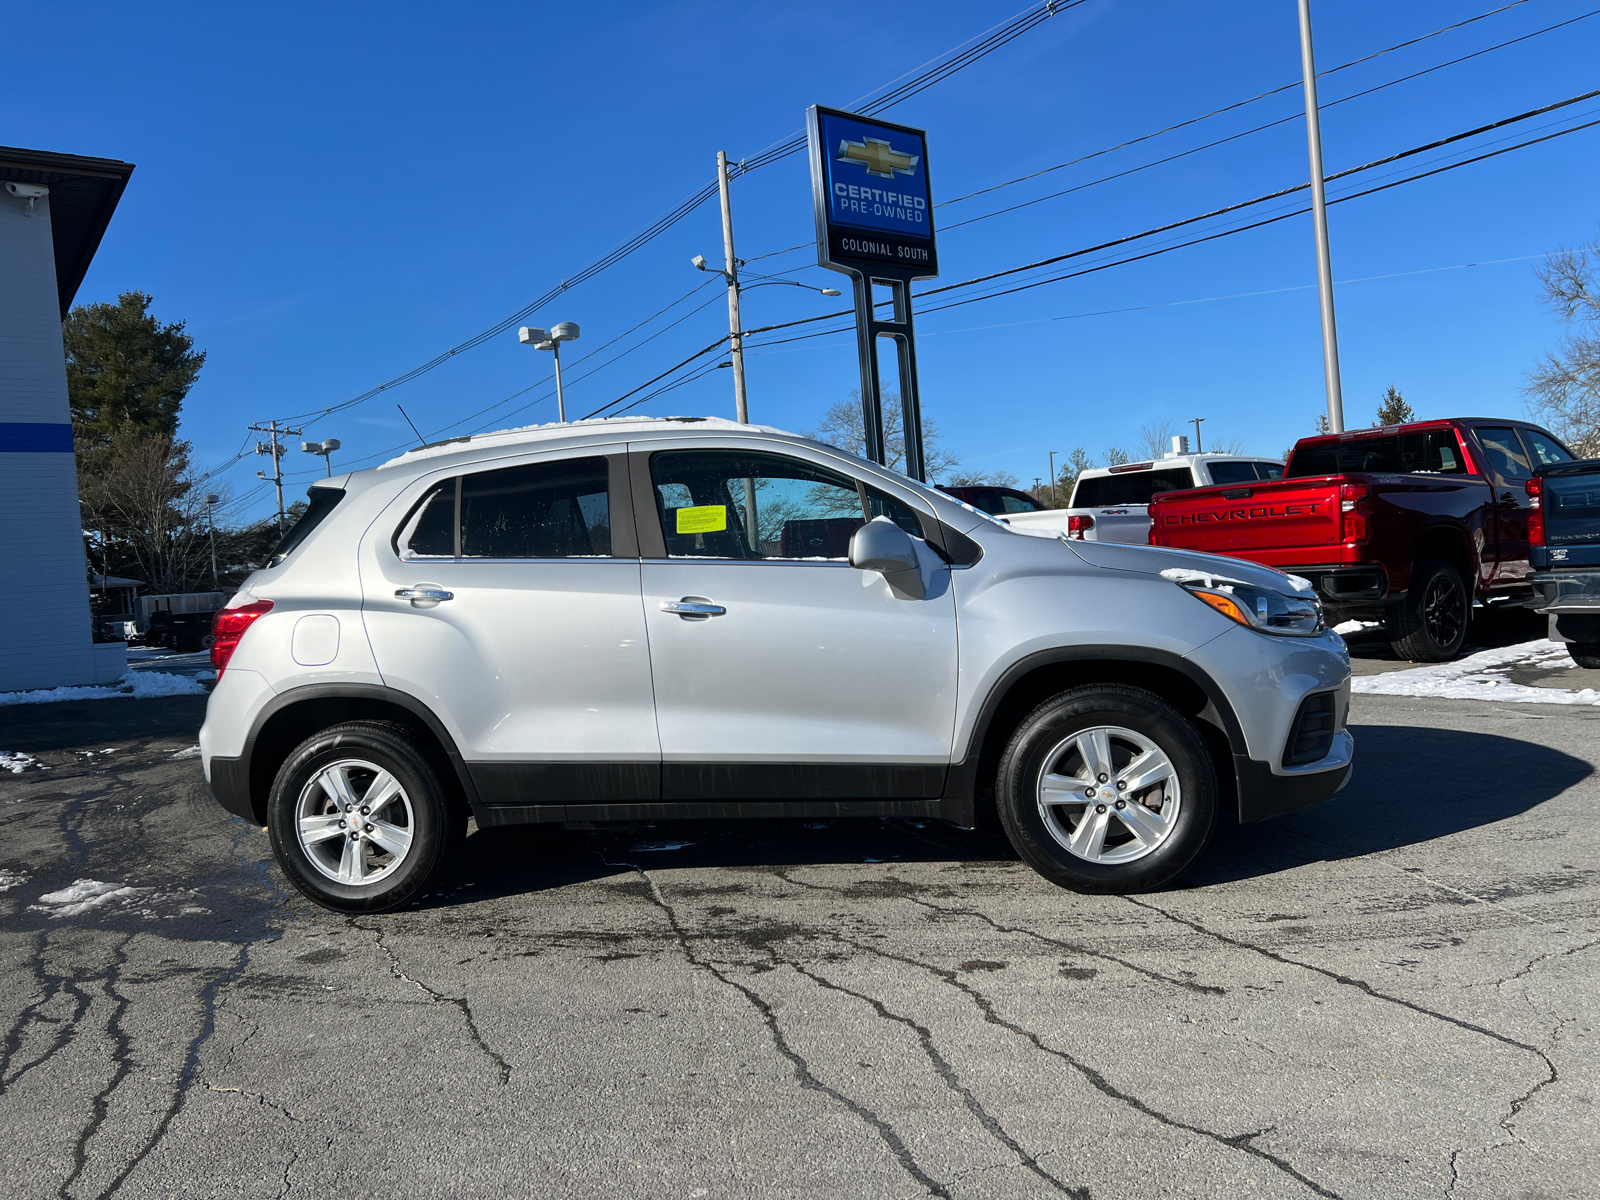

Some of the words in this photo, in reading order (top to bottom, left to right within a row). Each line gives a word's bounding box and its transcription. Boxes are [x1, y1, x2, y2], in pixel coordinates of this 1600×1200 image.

[835, 182, 926, 210] CERTIFIED
[841, 198, 923, 223] PRE-OWNED
[842, 238, 893, 256] COLONIAL
[898, 245, 929, 261] SOUTH
[1165, 503, 1323, 526] CHEVROLET
[1058, 699, 1134, 721] KELLY
